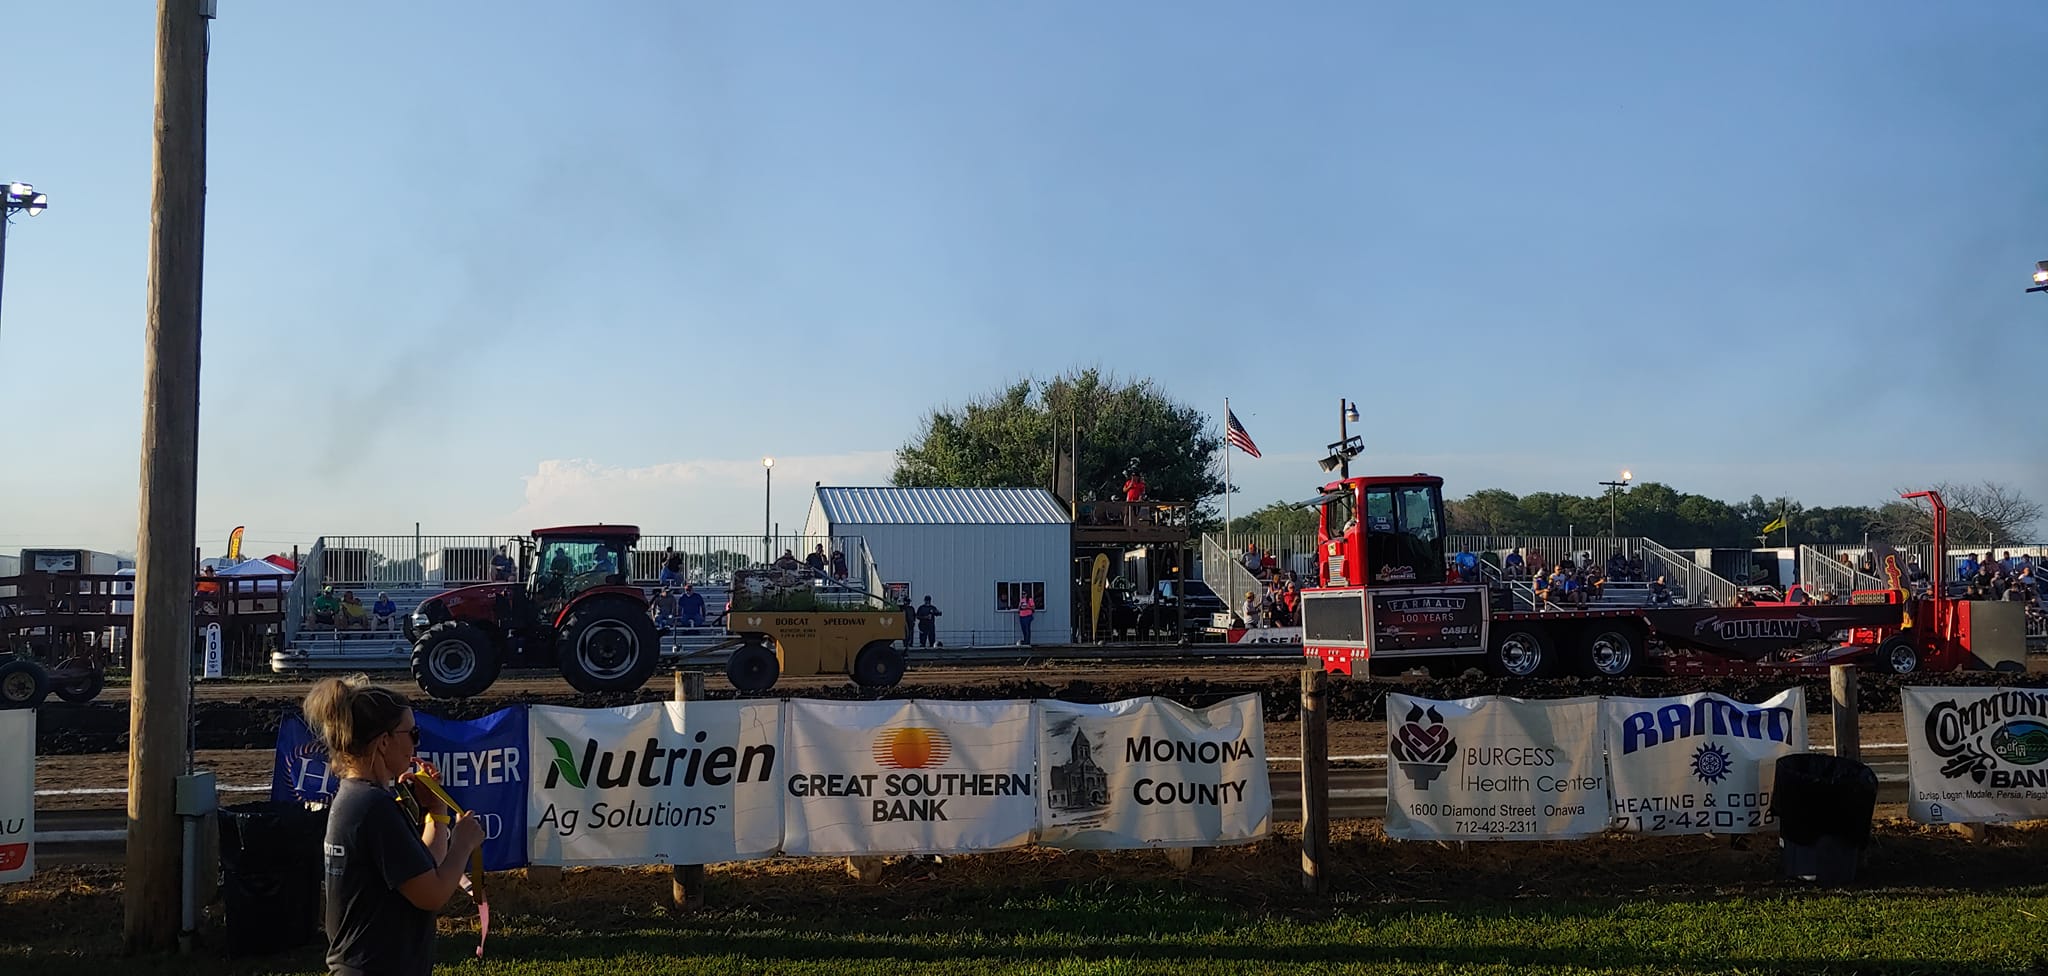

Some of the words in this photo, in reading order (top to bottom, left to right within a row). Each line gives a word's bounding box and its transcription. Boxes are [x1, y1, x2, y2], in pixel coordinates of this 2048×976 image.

[1393, 599, 1462, 610] FARMALL
[775, 618, 809, 626] BOBCAT
[823, 618, 866, 626] SPEEDWAY
[1401, 614, 1419, 623] 100
[1423, 613, 1454, 622] YEARS
[1721, 618, 1801, 640] OUTLAW
[1440, 626, 1468, 635] CASE
[1623, 697, 1793, 756] RAMM
[1925, 690, 2048, 758] COMMUNI
[544, 731, 776, 790] Nutrien
[1125, 736, 1255, 764] MONONA
[1467, 748, 1555, 766] BURGESS
[788, 774, 878, 797] GREAT
[884, 773, 1031, 797] SOUTHERN
[1133, 778, 1247, 806] COUNTY
[1467, 775, 1530, 792] Health
[1537, 775, 1603, 793] Center
[872, 799, 949, 823] BANK
[1409, 803, 1437, 816] 1600
[1442, 804, 1496, 817] Diamond
[1500, 804, 1536, 817] Street
[1544, 804, 1585, 817] Onawa
[1615, 794, 1694, 814] HEATING
[1704, 793, 1717, 808] &
[1728, 792, 1770, 808] COO
[537, 803, 579, 837] Ag
[1456, 821, 1537, 833] 712-423-2311
[1616, 808, 1776, 832] 712-420-26
